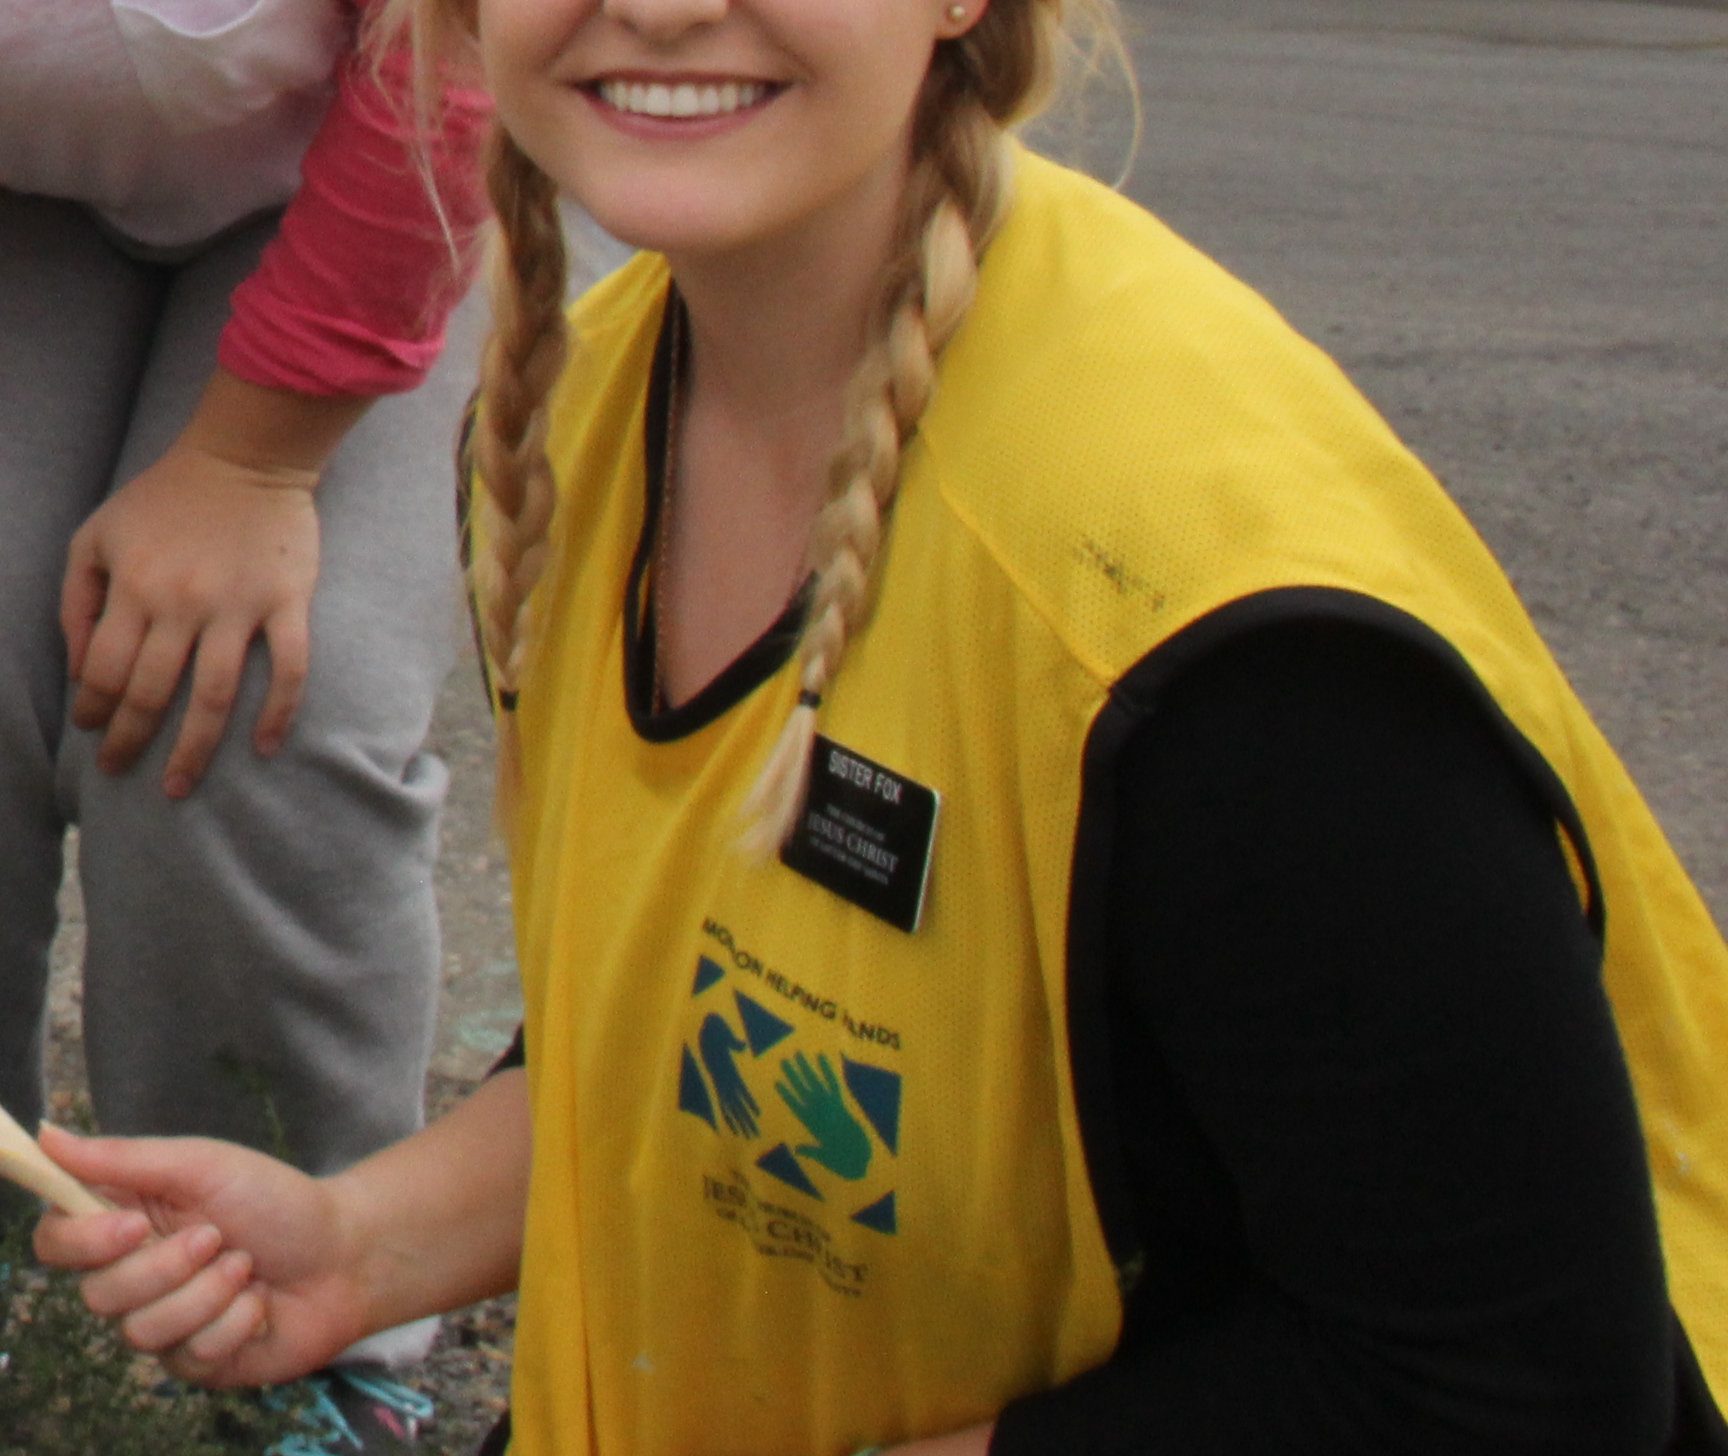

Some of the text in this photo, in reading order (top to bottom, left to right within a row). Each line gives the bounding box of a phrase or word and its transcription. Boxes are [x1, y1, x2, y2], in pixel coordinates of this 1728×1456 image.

[828, 749, 903, 803] SISTER FOX
[846, 833, 899, 873] CHRIST
[766, 968, 838, 1021] HELPING
